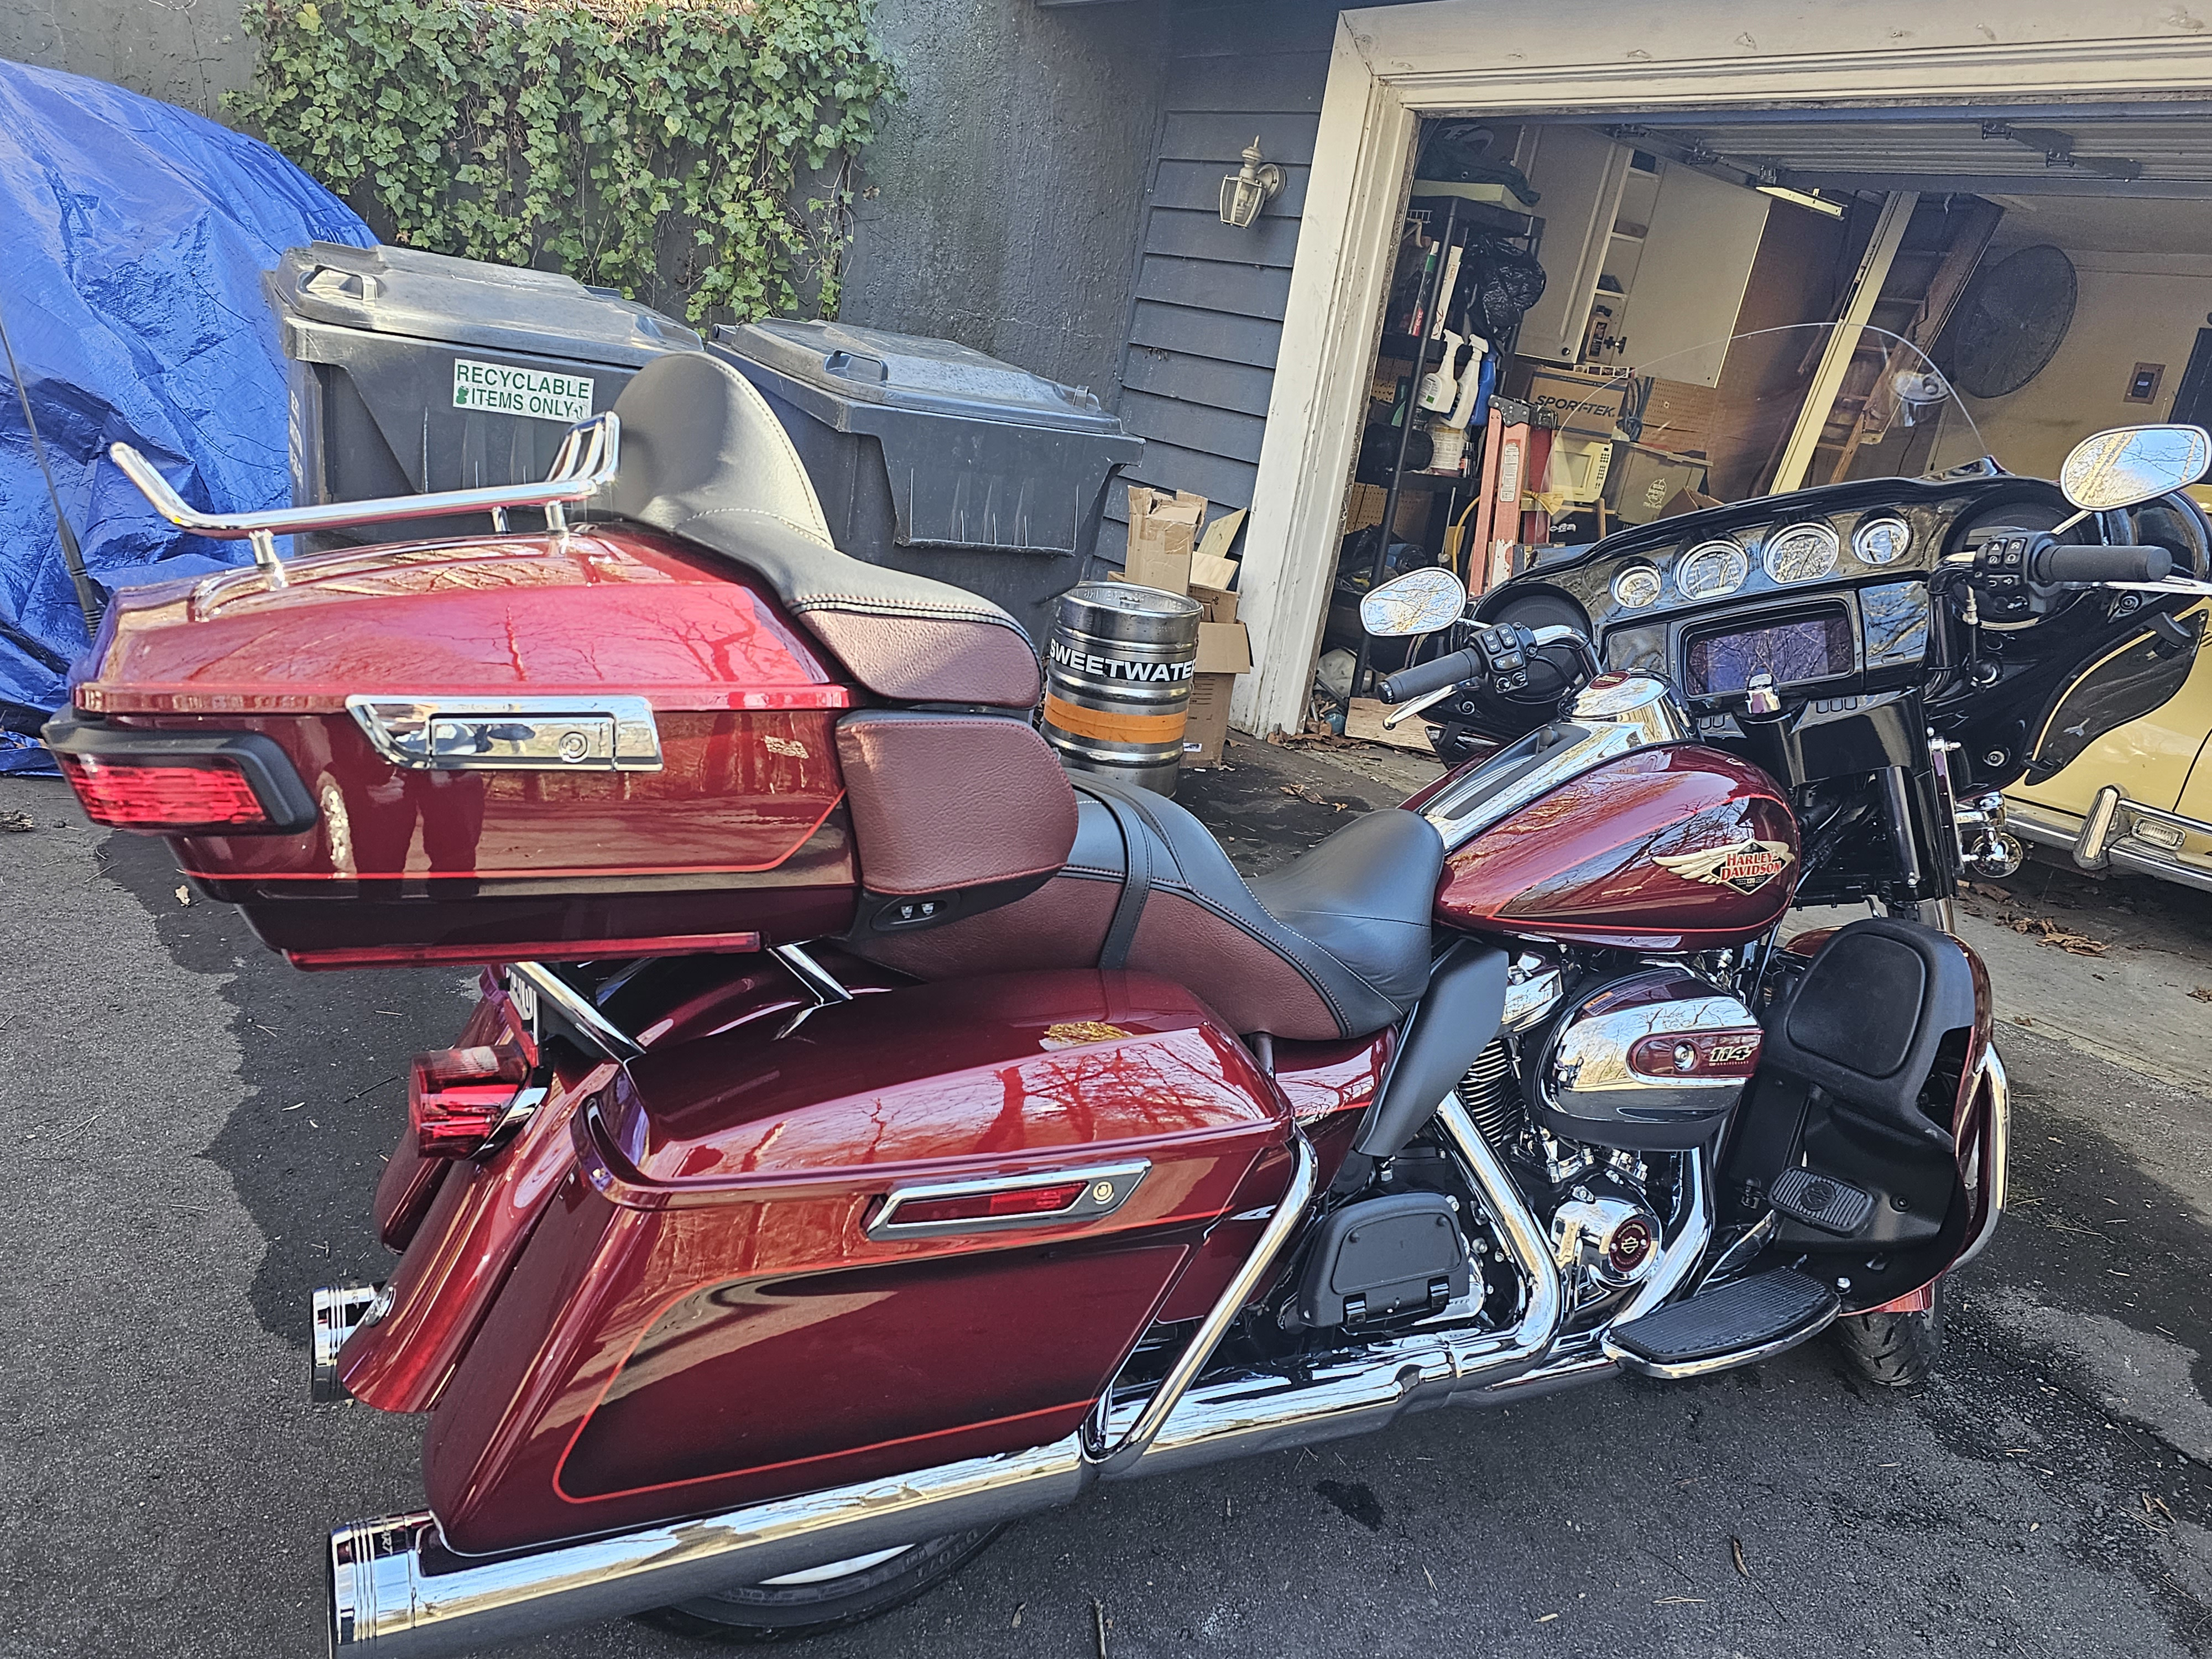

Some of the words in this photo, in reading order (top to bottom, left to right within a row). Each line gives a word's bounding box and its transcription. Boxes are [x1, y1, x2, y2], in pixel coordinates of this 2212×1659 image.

[457, 364, 589, 399] RECYCLABLE
[472, 388, 524, 410] ITEMS
[529, 397, 574, 418] ONLY
[1536, 395, 1616, 417] SPORT-TEK
[1721, 862, 1781, 881] DAVIDSON
[1709, 1046, 1752, 1062] 114
